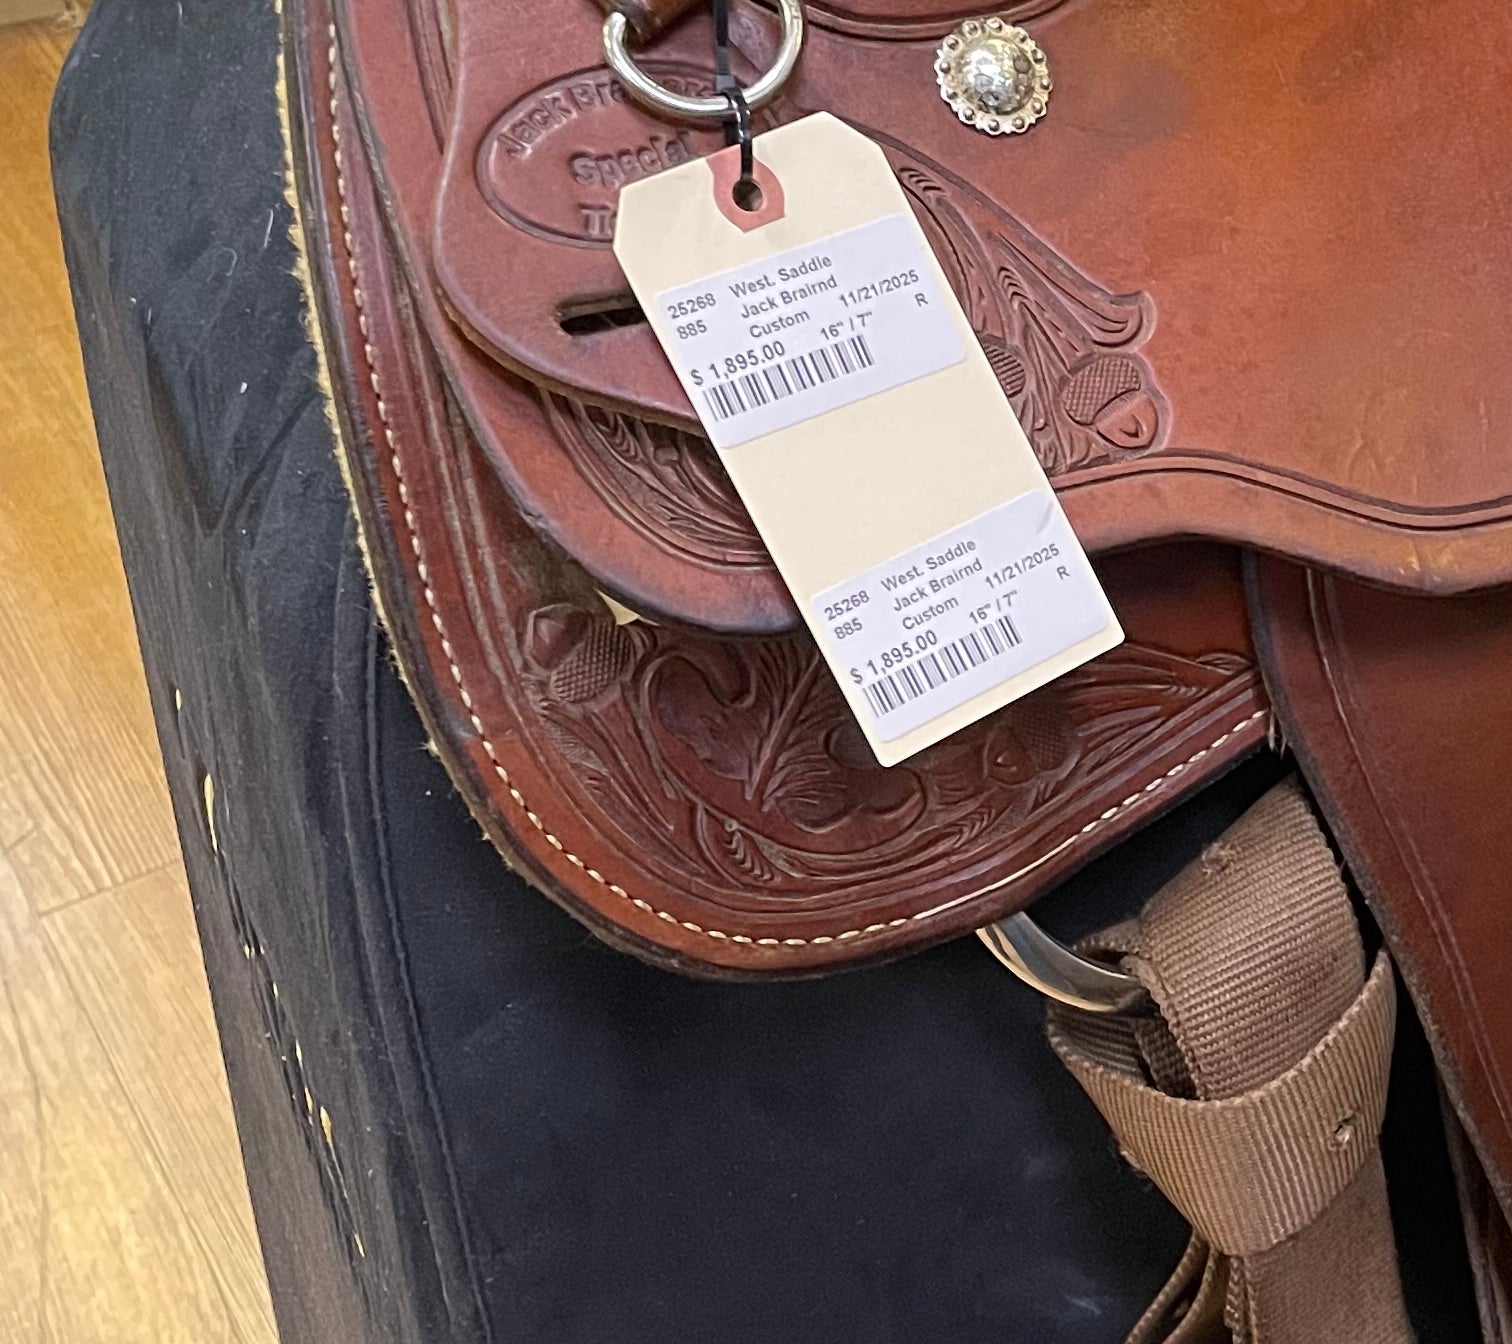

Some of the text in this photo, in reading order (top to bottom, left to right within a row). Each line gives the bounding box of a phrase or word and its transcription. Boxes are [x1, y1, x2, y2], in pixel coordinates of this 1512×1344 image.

[499, 91, 578, 160] Jack
[728, 255, 833, 299] West. Saddle
[838, 268, 920, 308] 11/21/2025
[667, 292, 717, 320] 25268
[740, 273, 838, 320] Jack Brairnd
[913, 291, 929, 308] R
[676, 319, 708, 340] 885
[749, 310, 811, 339] Custom
[820, 320, 844, 341] 16"
[690, 339, 787, 387] $ 1,895.00
[880, 539, 977, 593] West. Saddle
[984, 542, 1061, 590] 11/21/2025
[1055, 565, 1071, 581] R
[892, 557, 984, 613] Jack Brairnd
[823, 589, 871, 622] 25268
[901, 596, 960, 631] Custom
[968, 602, 992, 625] 16"
[833, 617, 864, 641] 885
[849, 628, 939, 685] $ 1,895.00
